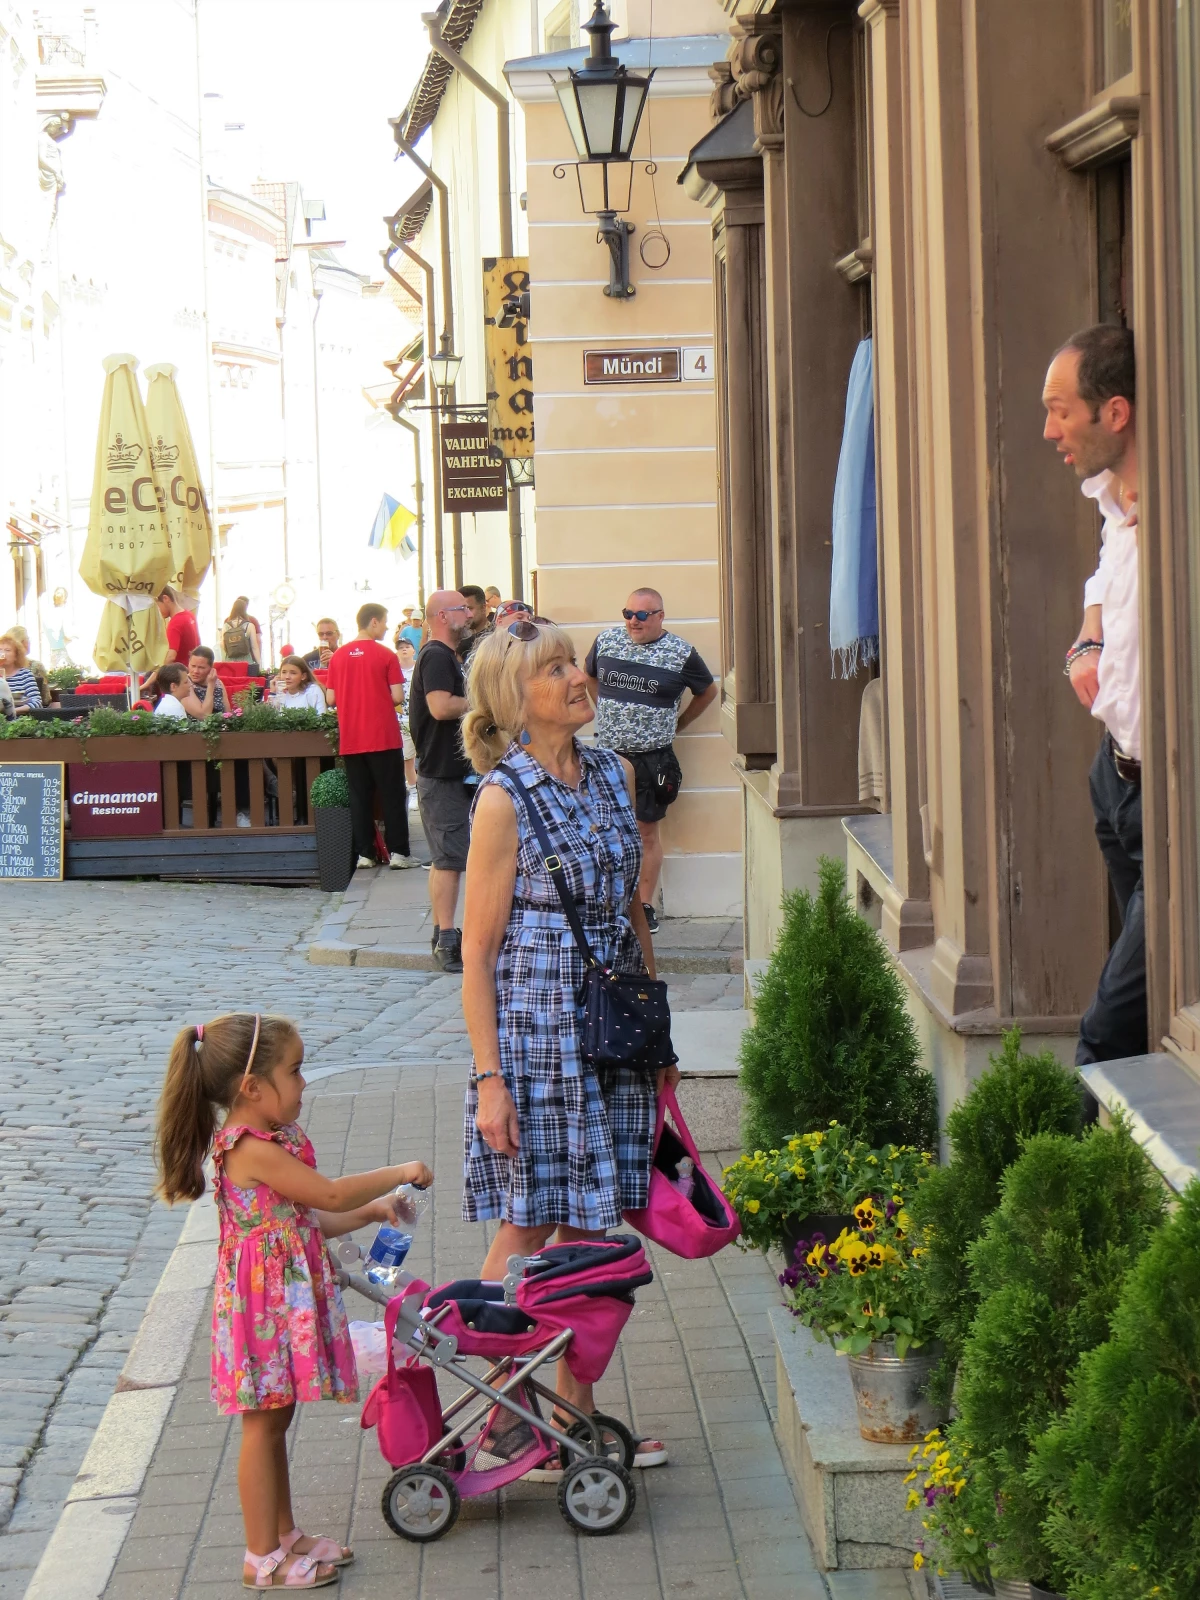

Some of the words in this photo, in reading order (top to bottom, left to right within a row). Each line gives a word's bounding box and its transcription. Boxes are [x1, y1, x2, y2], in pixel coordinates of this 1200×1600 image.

[603, 356, 663, 375] Mündi
[694, 355, 707, 373] 4
[445, 455, 502, 468] VAHETUS
[447, 486, 504, 499] EXCHANGE
[109, 541, 145, 550] 1807
[2, 795, 27, 805] SALMON
[73, 791, 158, 805] Cinnamon
[2, 804, 20, 814] STEAK
[92, 806, 140, 815] Restoran
[7, 823, 28, 835] TIKKA
[1, 833, 29, 845] CHICKEN
[1, 844, 22, 856] LAMB
[10, 855, 35, 867] MASALA
[5, 866, 34, 877] NUGGETS
